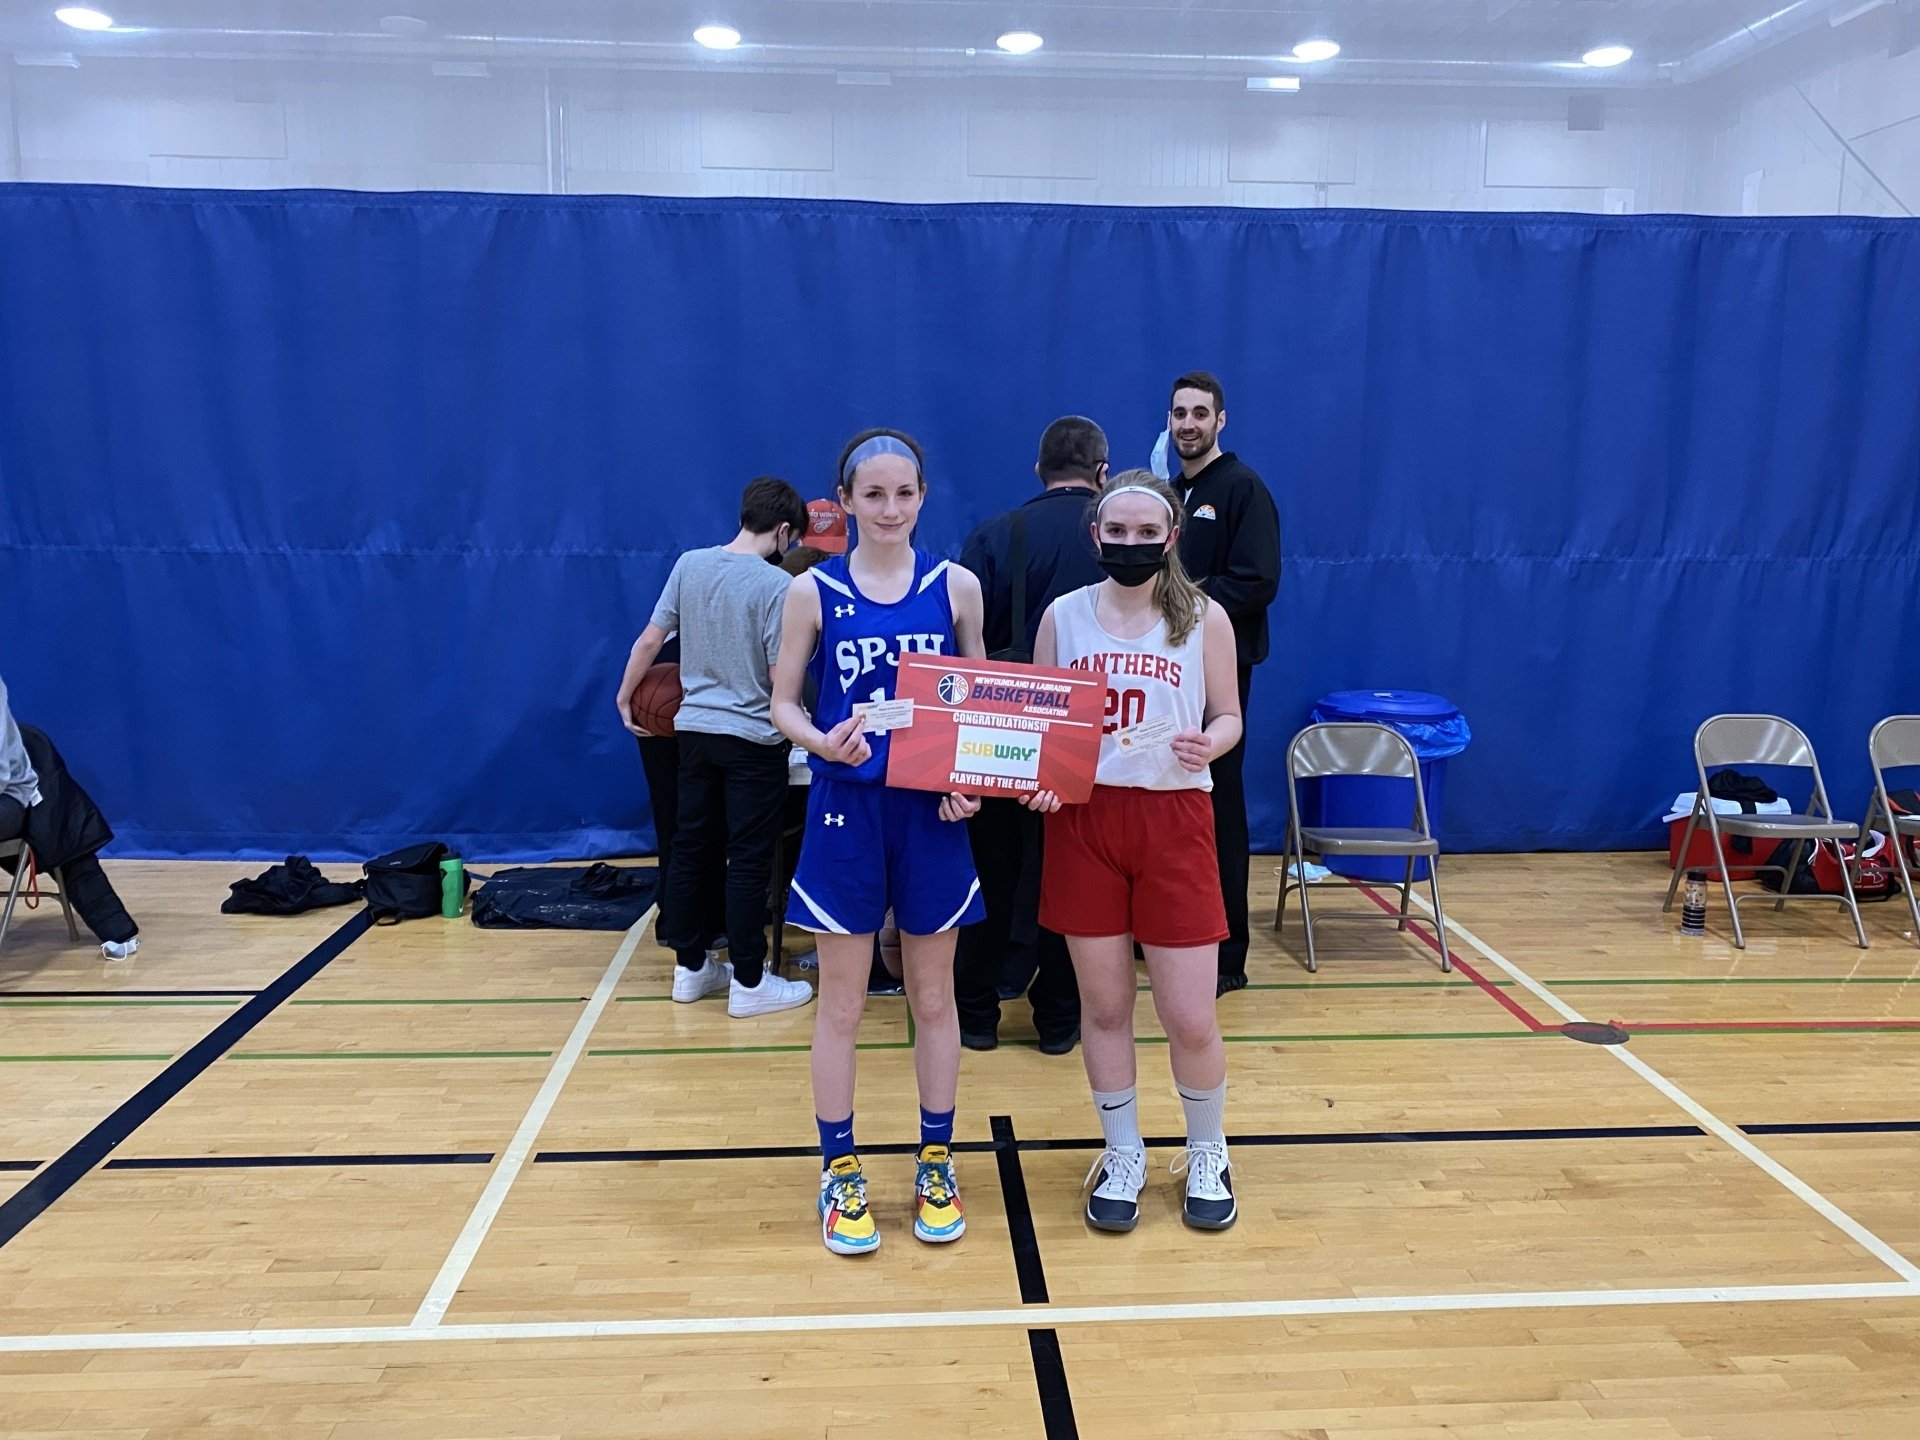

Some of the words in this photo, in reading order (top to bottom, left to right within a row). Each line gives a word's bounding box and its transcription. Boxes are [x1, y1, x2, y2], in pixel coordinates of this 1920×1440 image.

[974, 676, 1029, 689] NEWFOUNDLAND
[1036, 682, 1072, 694] LABRADOR
[971, 685, 1071, 709] BASKETBALL
[1022, 705, 1069, 717] ASSOCIATION
[953, 712, 1050, 732] CONGRATULATIONS!!!
[960, 742, 1037, 761] SUBWAY
[949, 772, 983, 786] PLAYER
[984, 776, 996, 787] OF
[997, 777, 1014, 789] THE
[1014, 779, 1040, 791] GAME
